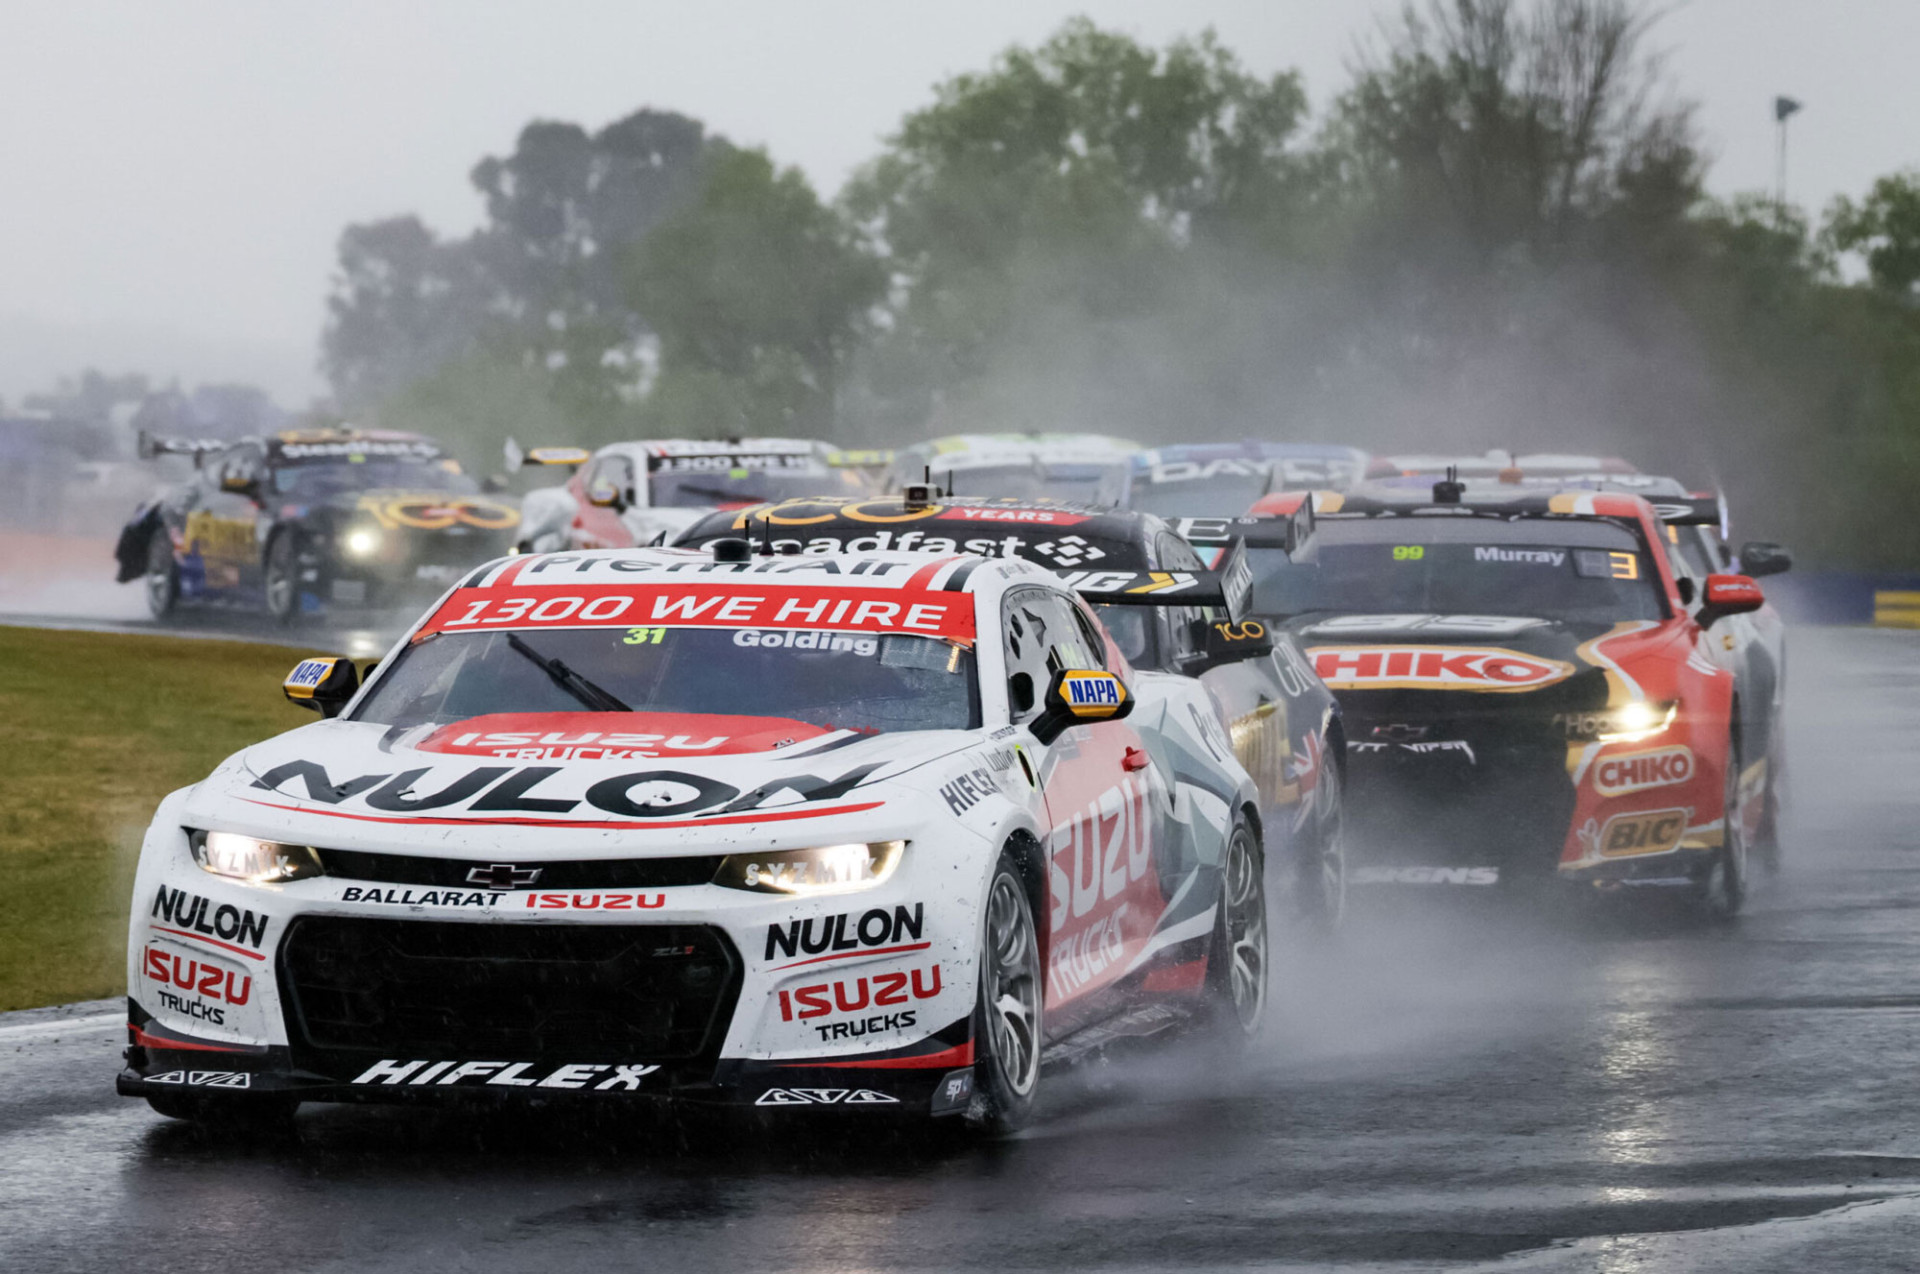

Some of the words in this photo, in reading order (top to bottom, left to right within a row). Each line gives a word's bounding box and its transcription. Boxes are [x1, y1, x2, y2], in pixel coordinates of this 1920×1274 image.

[963, 509, 1054, 522] YEARS
[700, 531, 1025, 558] teadfast
[1393, 546, 1424, 560] 99
[1474, 547, 1565, 566] Murray
[444, 596, 634, 627] 1300
[651, 596, 771, 621] WE
[773, 598, 948, 630] HIRE
[622, 628, 667, 645] 31
[733, 629, 878, 656] Golding
[289, 661, 328, 685] NAPA
[1308, 652, 1554, 683] HIKO
[1069, 679, 1119, 704] NAPA
[451, 731, 729, 751] ISUZU
[492, 747, 660, 760] TRUCKS
[1600, 753, 1689, 788] CHIKO
[248, 757, 894, 819] NULON
[939, 766, 1002, 818] HIFLEX
[198, 845, 294, 878] SYZMIK
[1050, 777, 1151, 934] SUZU
[744, 857, 878, 887] SYZMIK
[341, 886, 506, 907] BALLARAT
[526, 892, 667, 910] ISUZU
[151, 884, 269, 949] NULON
[764, 902, 925, 961] NULON
[1049, 903, 1129, 1000] TRUCKS
[144, 944, 252, 1006] ISUZU
[157, 989, 225, 1026] TRUCKS
[778, 964, 942, 1022] ISUZU
[815, 1010, 916, 1042] TRUCKS
[352, 1059, 660, 1091] HIFLEX
